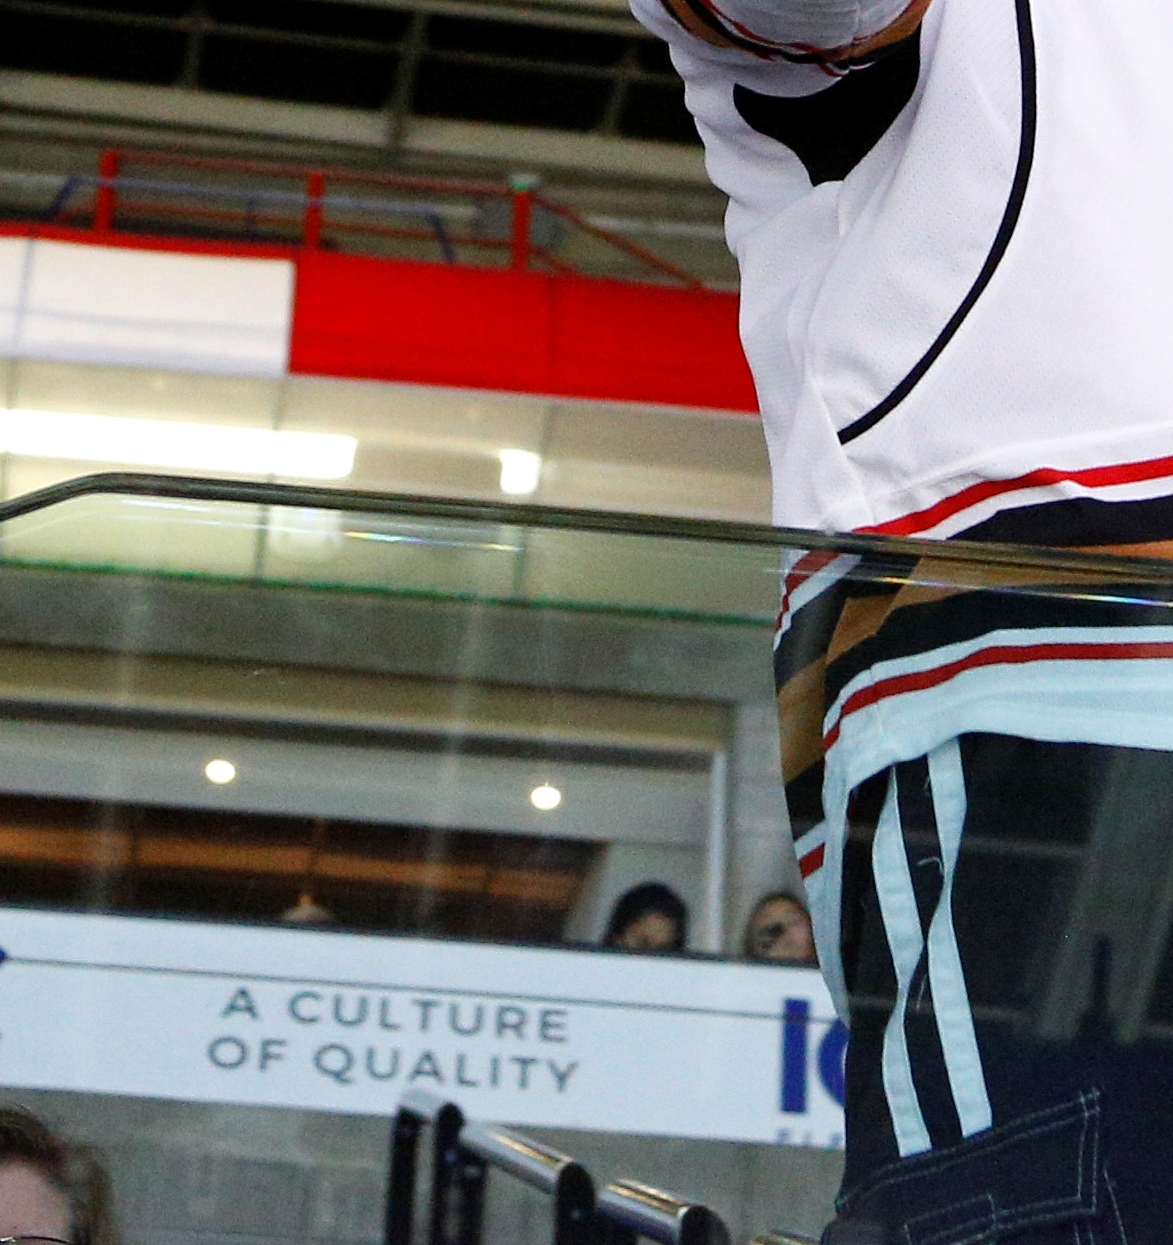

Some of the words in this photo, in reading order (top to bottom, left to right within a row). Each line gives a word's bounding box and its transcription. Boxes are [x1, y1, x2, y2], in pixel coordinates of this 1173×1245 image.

[220, 986, 258, 1021] A
[287, 991, 568, 1043] CULTURE
[207, 1036, 287, 1071] OF
[313, 1042, 579, 1093] QUALITY
